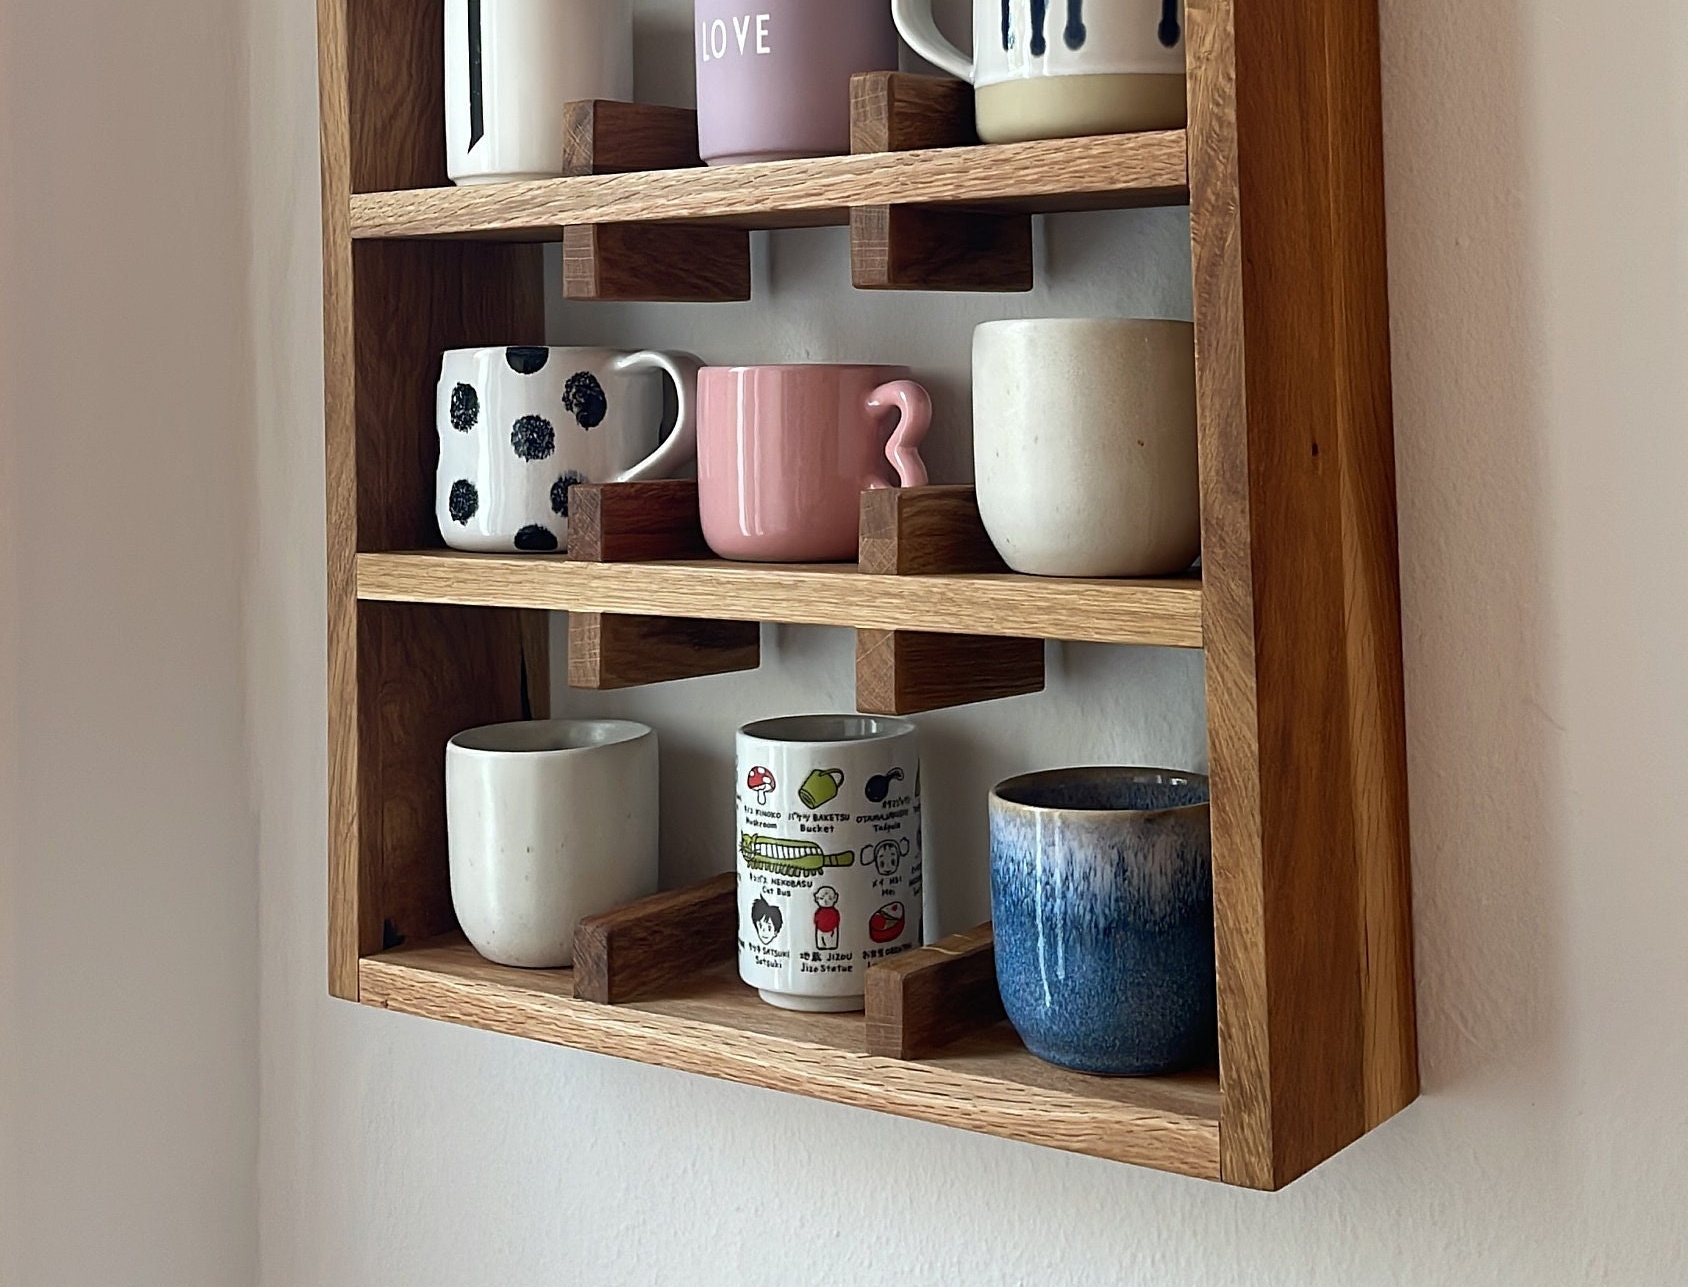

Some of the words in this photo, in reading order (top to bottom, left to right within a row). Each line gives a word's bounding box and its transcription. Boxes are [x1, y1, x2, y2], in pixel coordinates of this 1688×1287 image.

[702, 14, 771, 62] LOVE
[812, 814, 850, 822] BAKETSU
[800, 824, 835, 833] Bucket
[771, 878, 813, 888] NEKOBASU
[762, 886, 774, 894] Cat
[777, 888, 791, 897] Bus
[827, 952, 853, 961] JIZOU
[801, 963, 819, 973] Jizo
[820, 964, 853, 973] Statue
